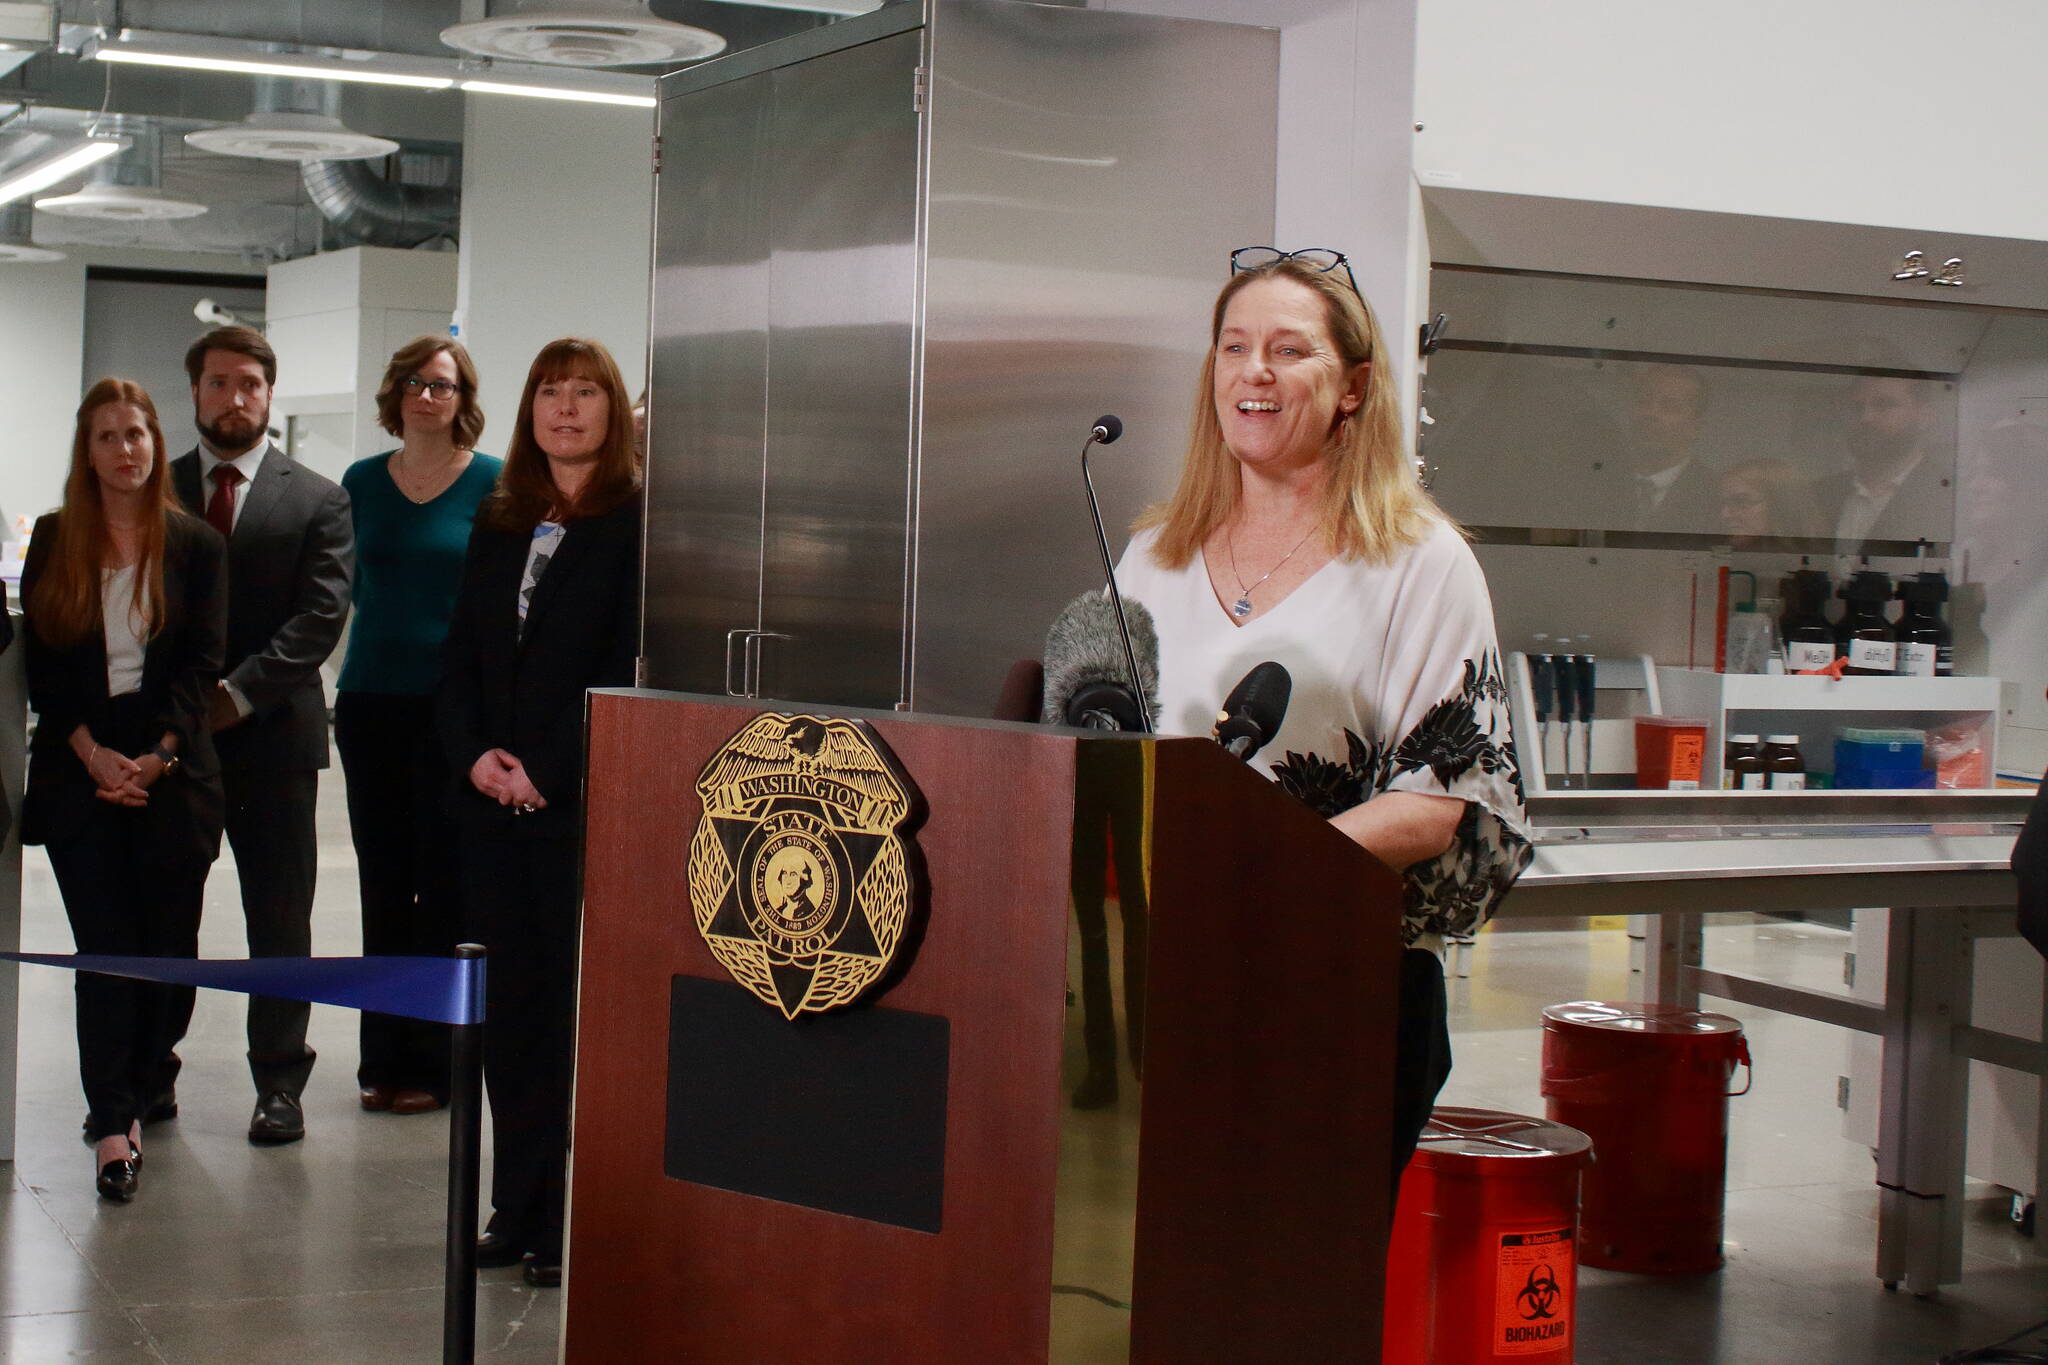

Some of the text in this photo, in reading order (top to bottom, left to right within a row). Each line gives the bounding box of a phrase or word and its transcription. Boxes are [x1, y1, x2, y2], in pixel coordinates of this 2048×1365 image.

[740, 775, 864, 811] WASHINGTON
[763, 814, 832, 845] STATE
[757, 837, 833, 928] THE SEAL OF THE STATE OF WASHINGTON
[751, 914, 837, 954] PATROL
[1505, 1322, 1564, 1342] BIOHAZARD
